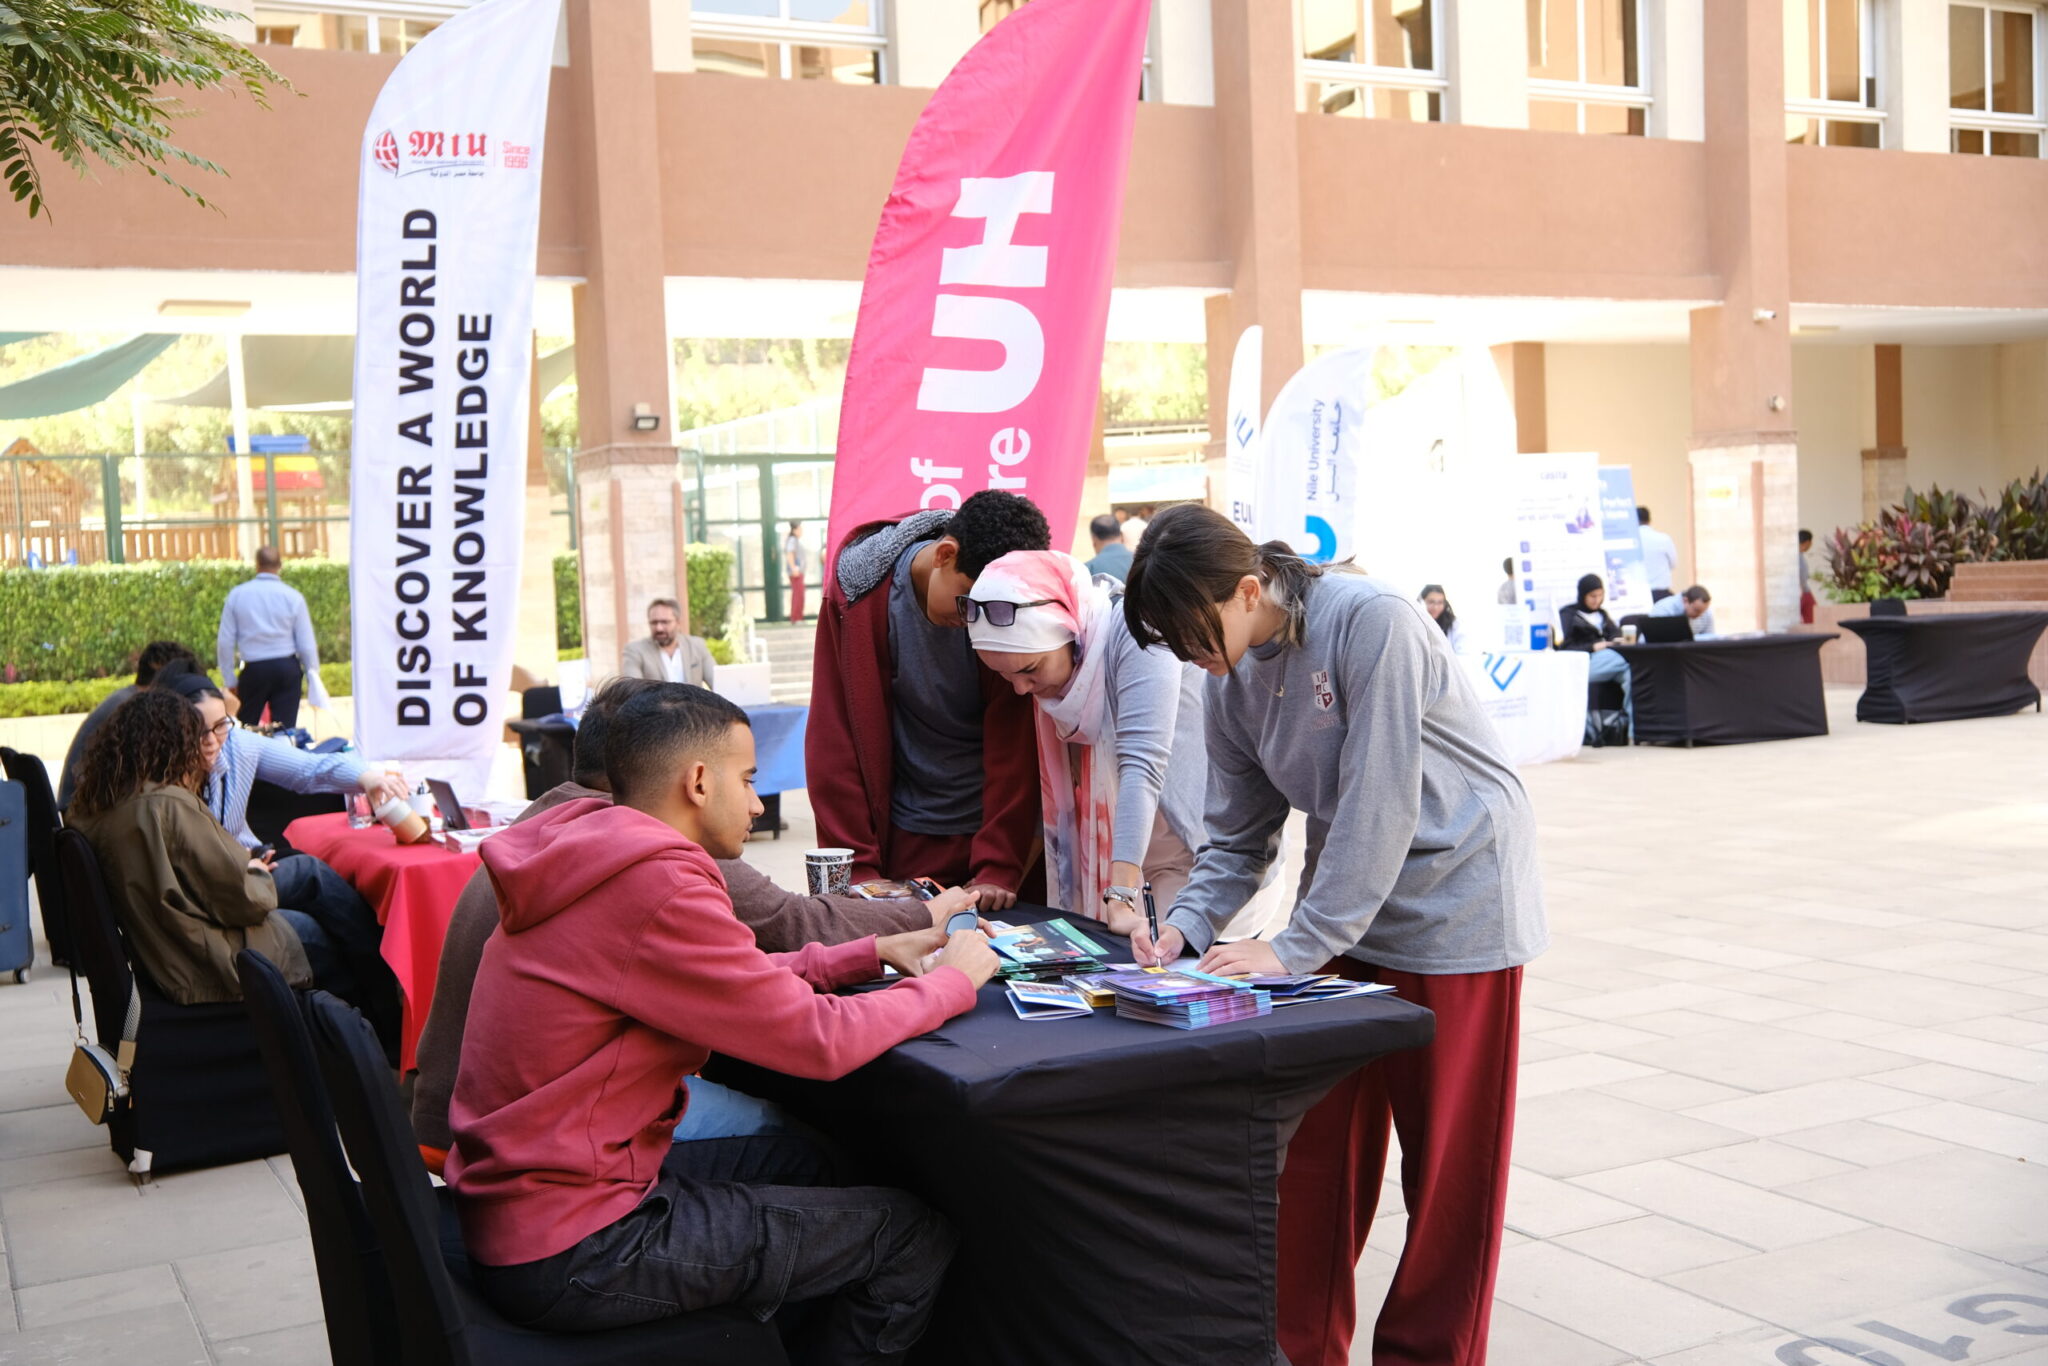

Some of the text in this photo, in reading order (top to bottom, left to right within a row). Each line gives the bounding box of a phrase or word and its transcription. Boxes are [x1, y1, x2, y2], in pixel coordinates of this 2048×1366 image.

[502, 140, 531, 156] Since
[504, 156, 529, 169] 1996
[916, 171, 1055, 413] UH
[395, 209, 437, 726] DISCOVER A WORLD
[988, 427, 1031, 498] re
[1306, 399, 1325, 501] Nile University
[452, 314, 492, 726] OF KNOWLEDGE
